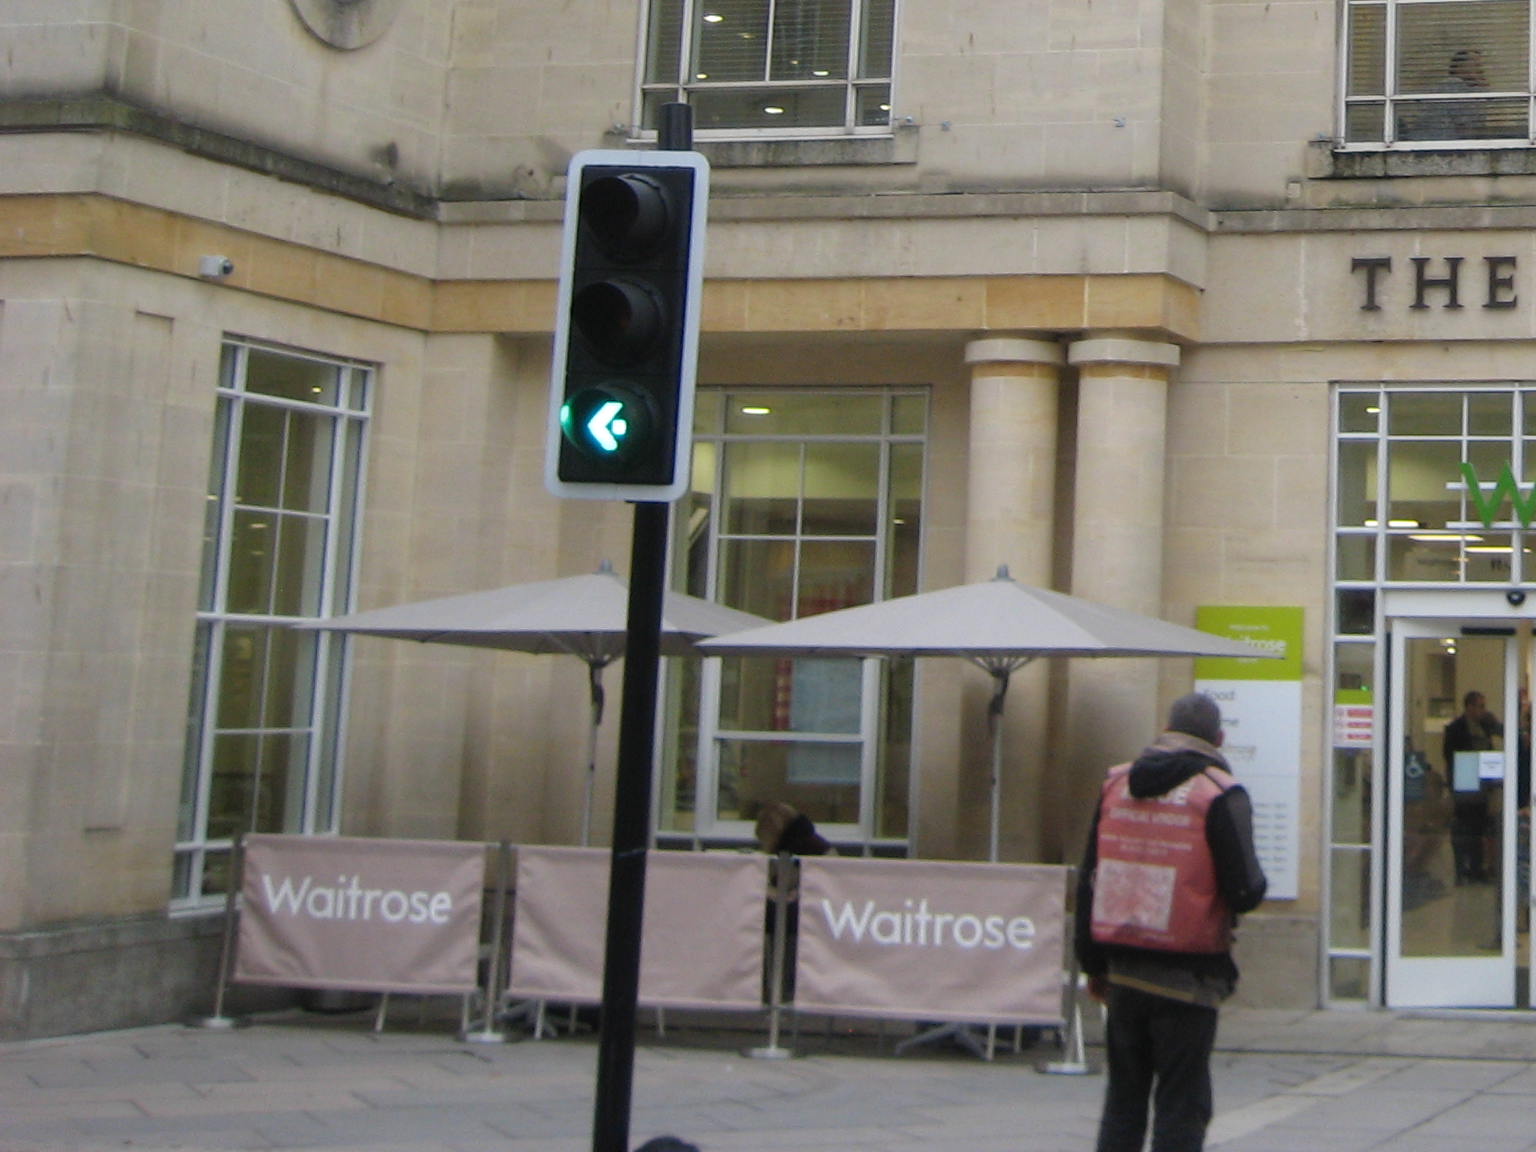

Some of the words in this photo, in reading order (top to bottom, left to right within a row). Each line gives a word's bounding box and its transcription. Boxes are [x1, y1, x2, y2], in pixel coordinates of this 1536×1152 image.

[1351, 255, 1519, 312] THE
[261, 874, 453, 925] Waitrose
[821, 897, 1037, 951] Waitrose
